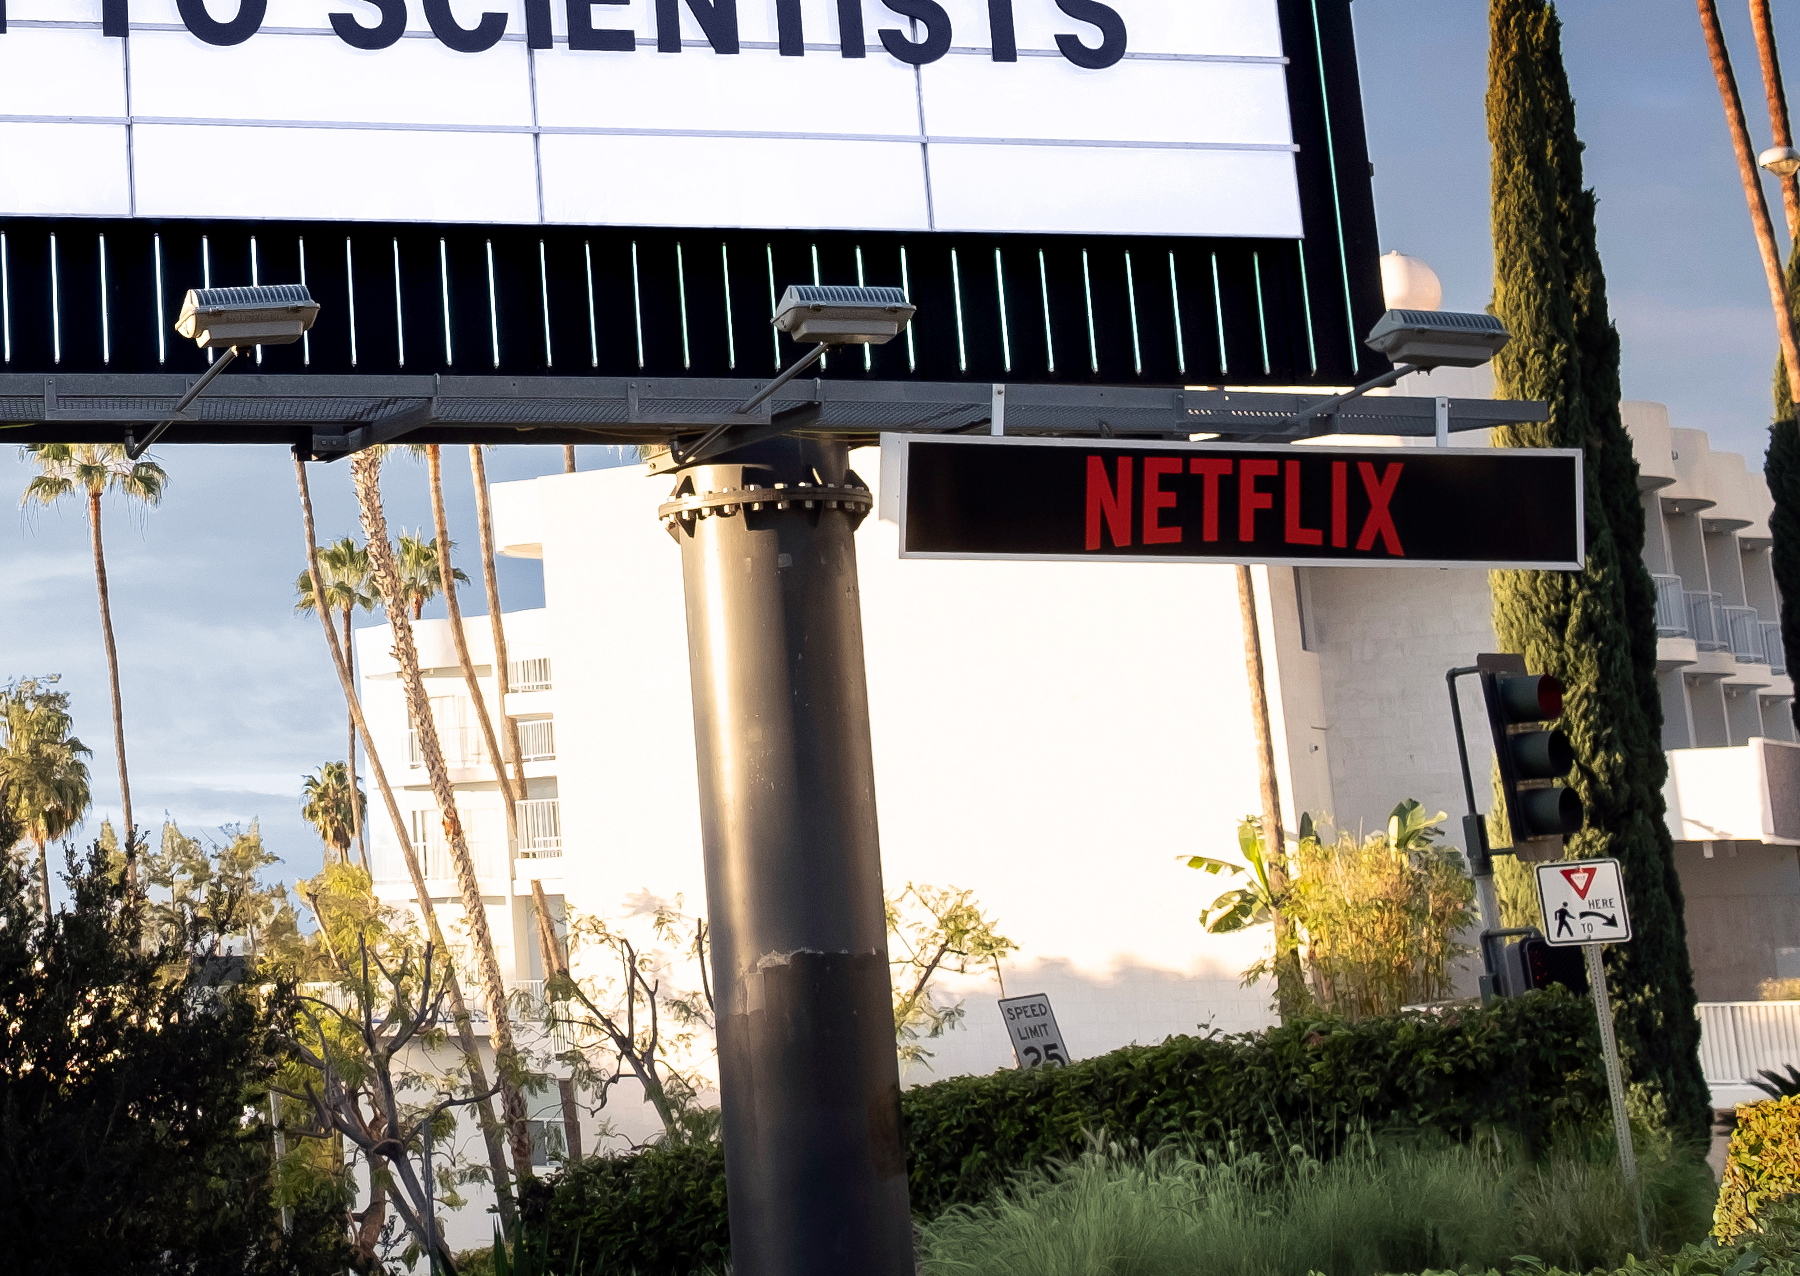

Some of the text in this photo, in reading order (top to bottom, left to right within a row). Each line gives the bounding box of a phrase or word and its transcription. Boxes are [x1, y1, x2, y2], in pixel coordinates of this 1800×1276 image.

[1085, 455, 1404, 556] NETFLIX
[1588, 898, 1616, 910] HERE
[1580, 922, 1594, 934] TO
[1006, 1003, 1048, 1021] SPEED
[1016, 1023, 1049, 1041] LIMIT
[1022, 1042, 1066, 1068] 25
